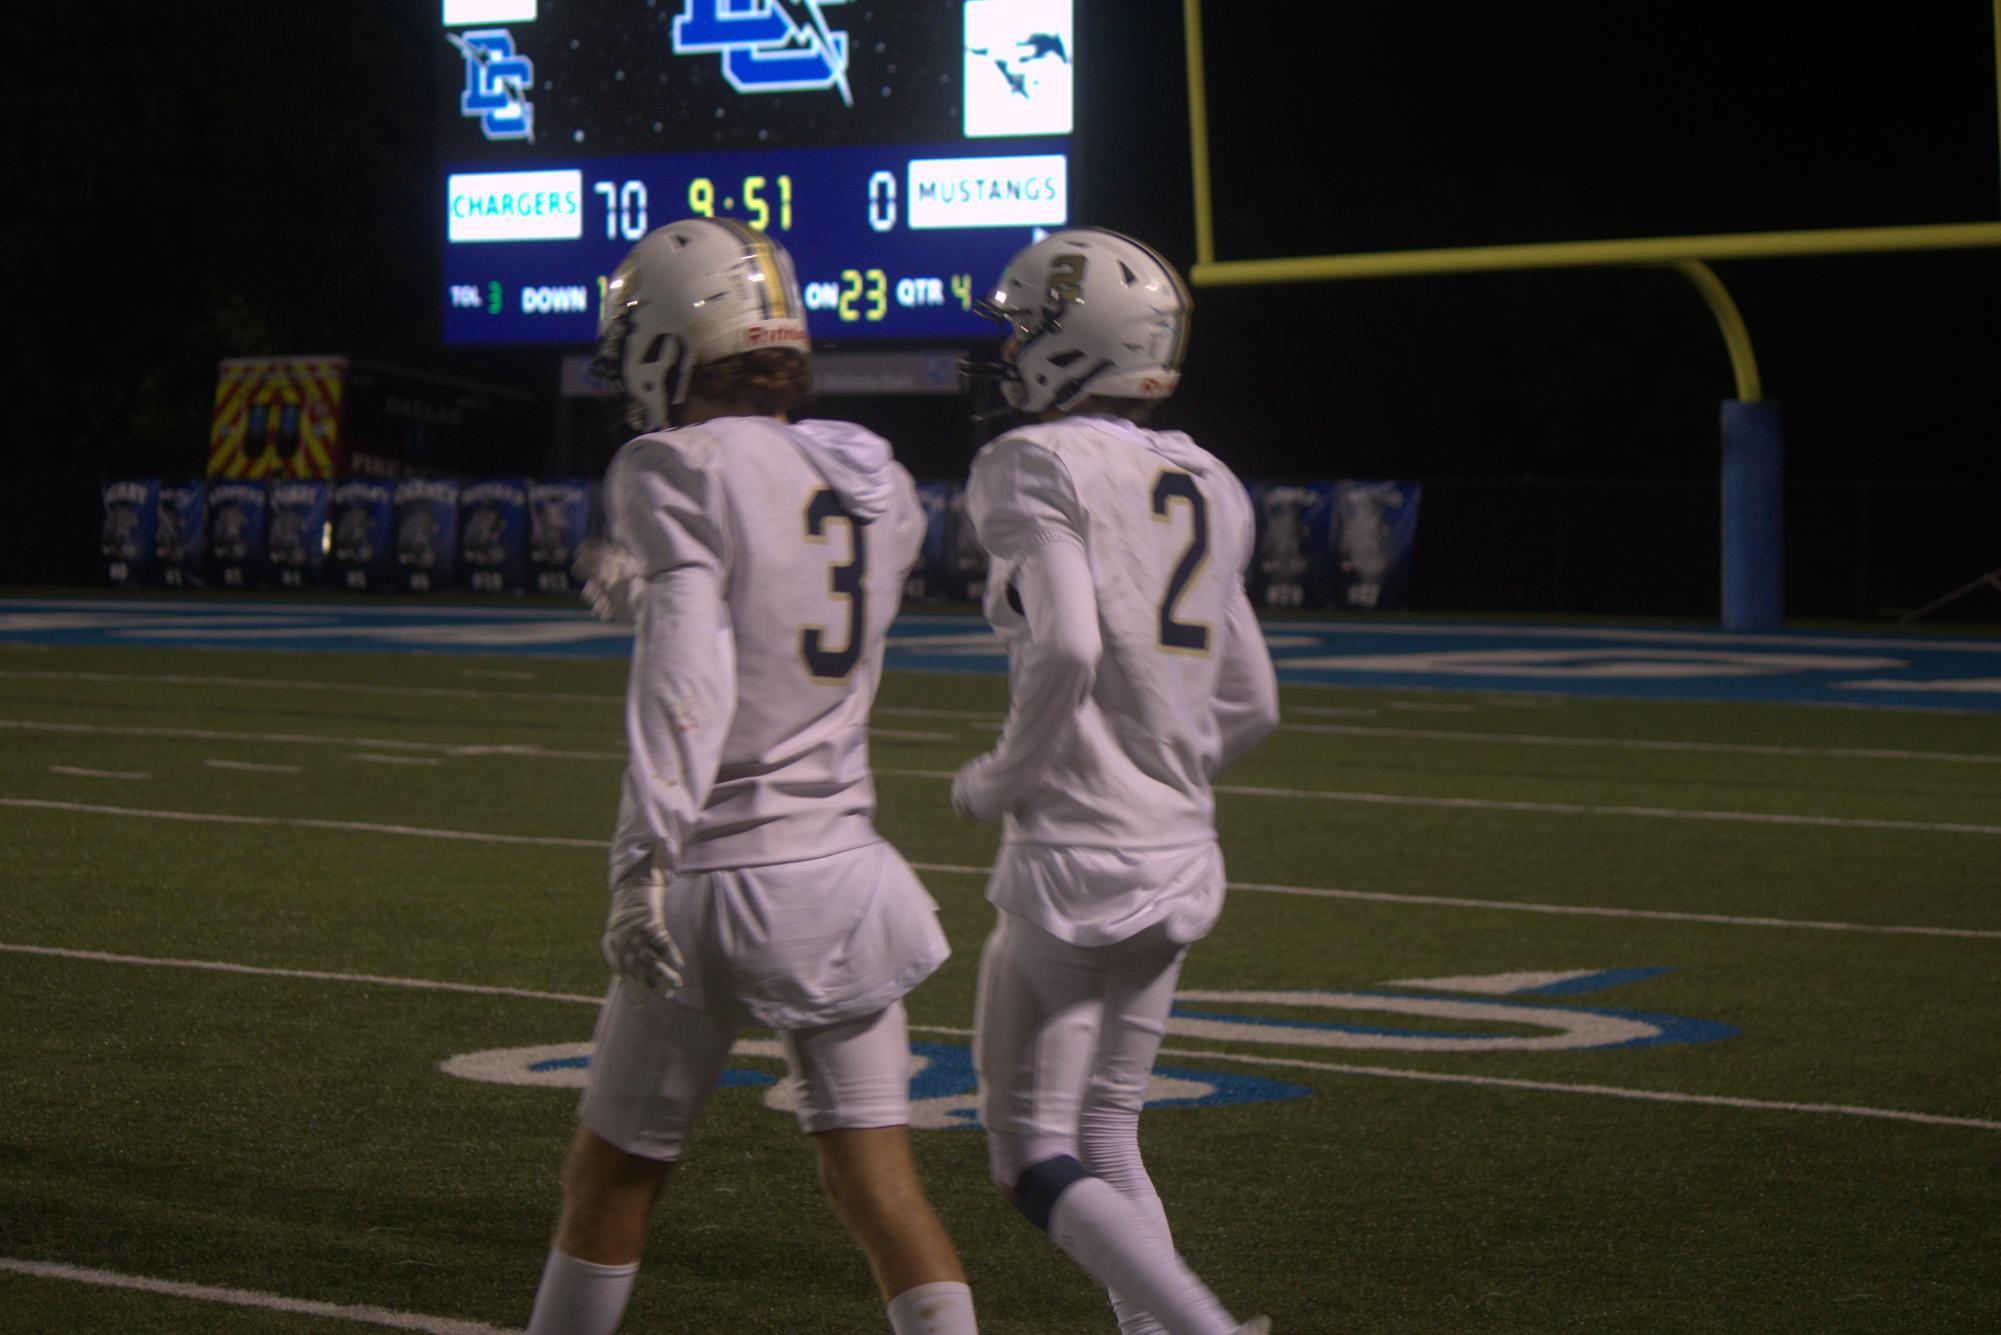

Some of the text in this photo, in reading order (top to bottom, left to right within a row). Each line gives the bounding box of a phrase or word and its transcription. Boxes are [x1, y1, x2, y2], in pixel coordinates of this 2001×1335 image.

[453, 191, 577, 219] CHARGERS
[594, 179, 648, 241] 70
[867, 169, 897, 232] 0
[918, 176, 1056, 204] MUSTANGS
[450, 284, 482, 307] TOL
[487, 281, 502, 315] 3
[521, 285, 587, 313] DOWN
[804, 282, 840, 310] ON
[838, 269, 887, 322] 23
[896, 278, 945, 308] QTR
[951, 273, 972, 312] 4
[1047, 253, 1088, 302] 2
[798, 484, 868, 687] 3
[1150, 469, 1215, 657] 2
